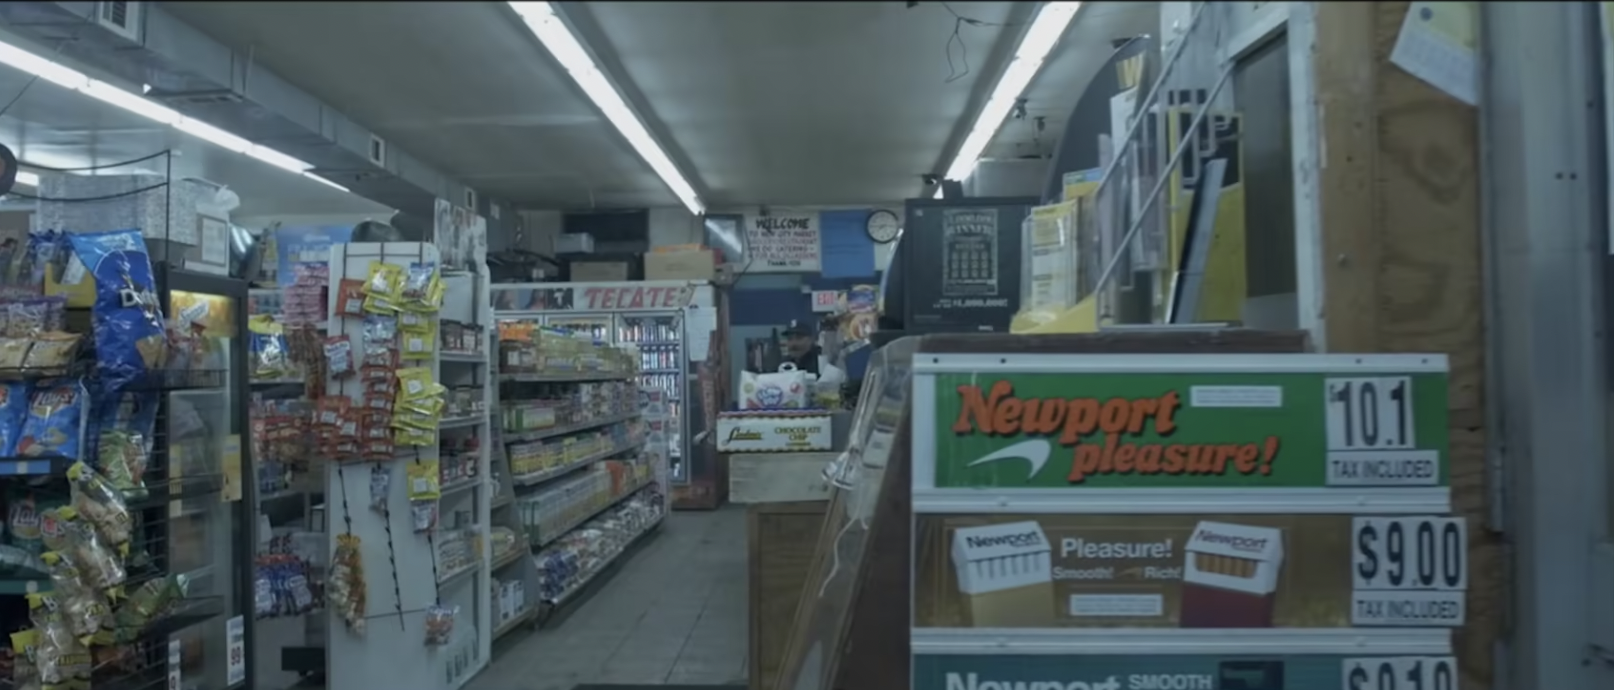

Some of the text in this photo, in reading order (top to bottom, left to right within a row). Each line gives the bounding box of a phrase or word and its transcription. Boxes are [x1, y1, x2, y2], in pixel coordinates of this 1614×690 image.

[756, 217, 810, 229] WELCOME
[584, 287, 679, 309] TECATE
[954, 380, 1179, 443] Newport
[1067, 433, 1279, 481] pleasure!
[1331, 460, 1434, 477] TAX INCLUDED
[966, 531, 1042, 548] Newport
[1060, 537, 1173, 557] Pleasure!
[1358, 520, 1461, 586] $9.00
[1053, 565, 1182, 578] Smooth! Rich!
[1357, 600, 1459, 618] TAX INCLUDED
[1128, 673, 1213, 690] SMOOTH
